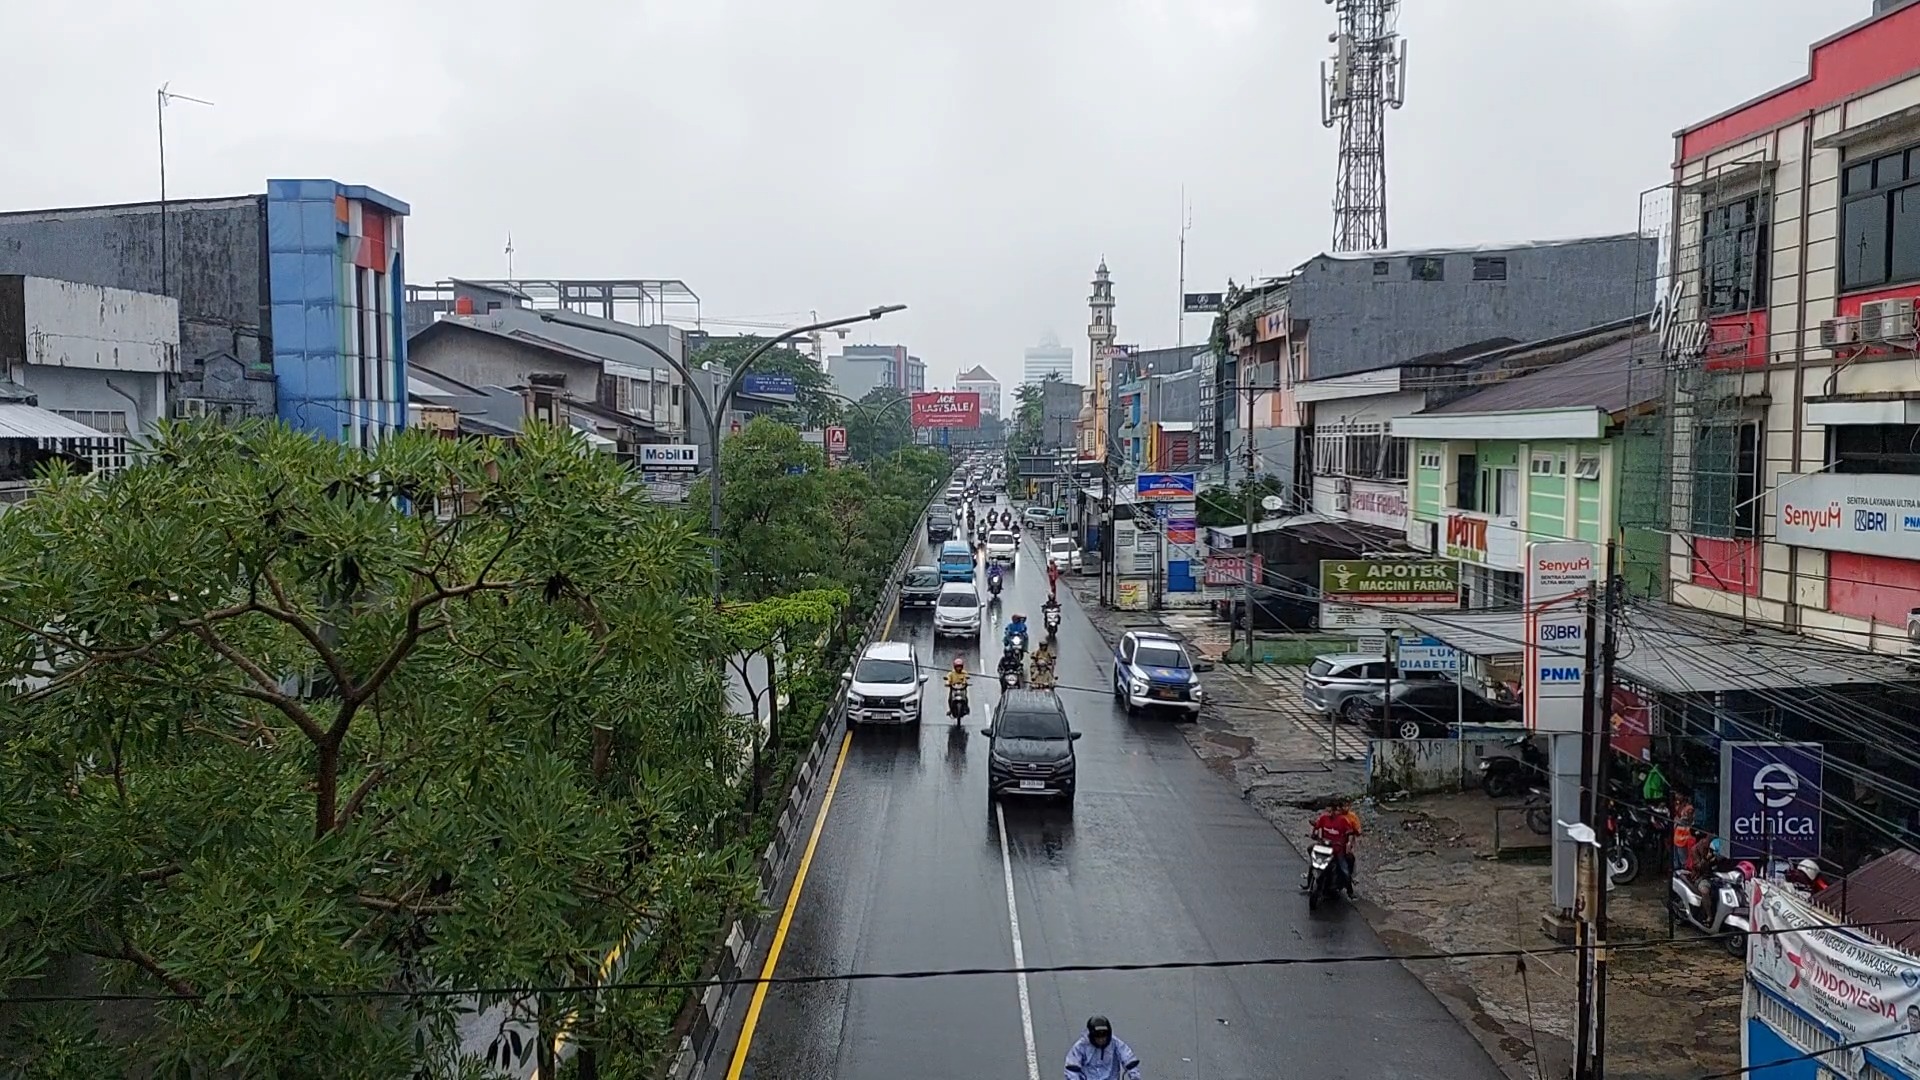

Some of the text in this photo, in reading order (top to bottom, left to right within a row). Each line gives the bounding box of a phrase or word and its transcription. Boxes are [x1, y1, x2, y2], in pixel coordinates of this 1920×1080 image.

[937, 395, 955, 403] ACE
[646, 449, 680, 460] Mobil
[1847, 496, 1868, 505] SENTRA
[1869, 497, 1896, 507] LAYANAN
[1897, 499, 1916, 508] ULTRA
[1867, 511, 1887, 531] BRI
[1366, 564, 1447, 578] APOTEK
[1359, 580, 1454, 591] MACCINI FARMA
[1557, 625, 1581, 639] BRI
[1429, 649, 1457, 657] LUK
[1400, 660, 1458, 668] DIABETE
[1541, 668, 1581, 681] PNM
[1734, 810, 1815, 834] ethica
[1823, 933, 1849, 954] NEGERI
[1846, 946, 1858, 959] 47
[1857, 948, 1899, 978] MAKASSAR
[1813, 966, 1898, 1023] INDONESIA
